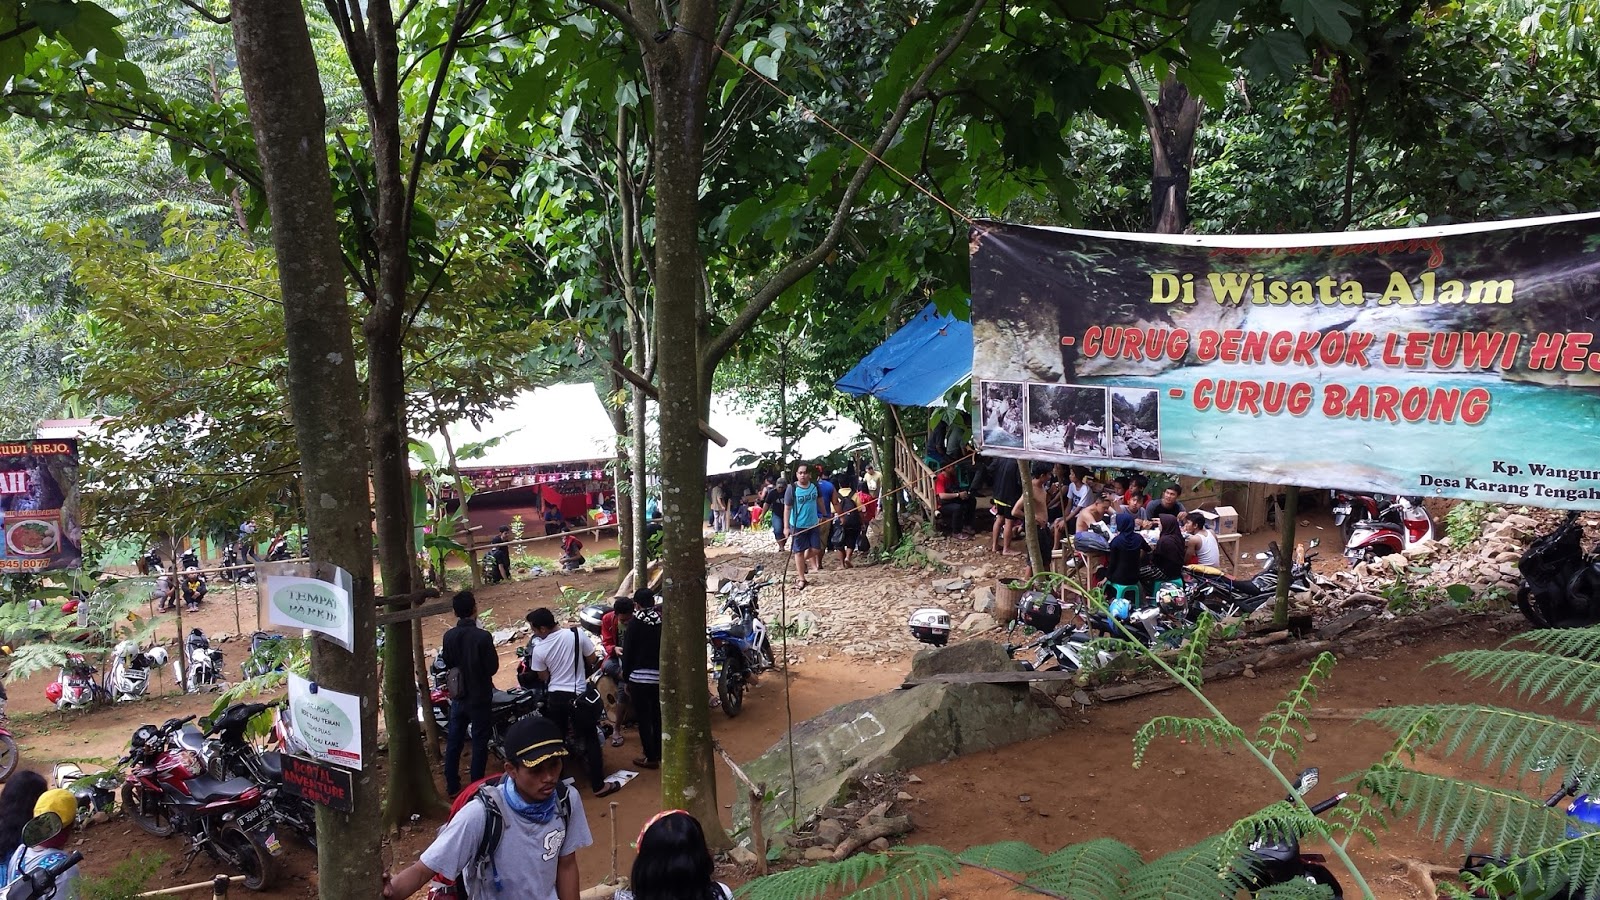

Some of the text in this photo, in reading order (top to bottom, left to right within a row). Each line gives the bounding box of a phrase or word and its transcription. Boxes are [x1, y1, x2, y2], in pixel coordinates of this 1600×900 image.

[1149, 271, 1515, 306] Di Wisata Alam
[1082, 325, 1190, 362] CURUG
[1197, 328, 1375, 369] BENGKOK
[1381, 331, 1522, 370] LEUWI
[1192, 378, 1313, 417] CURUG
[1321, 383, 1491, 425] BARONG
[1492, 460, 1524, 477] Kp.
[1420, 474, 1600, 501] Desa Karang Tengah
